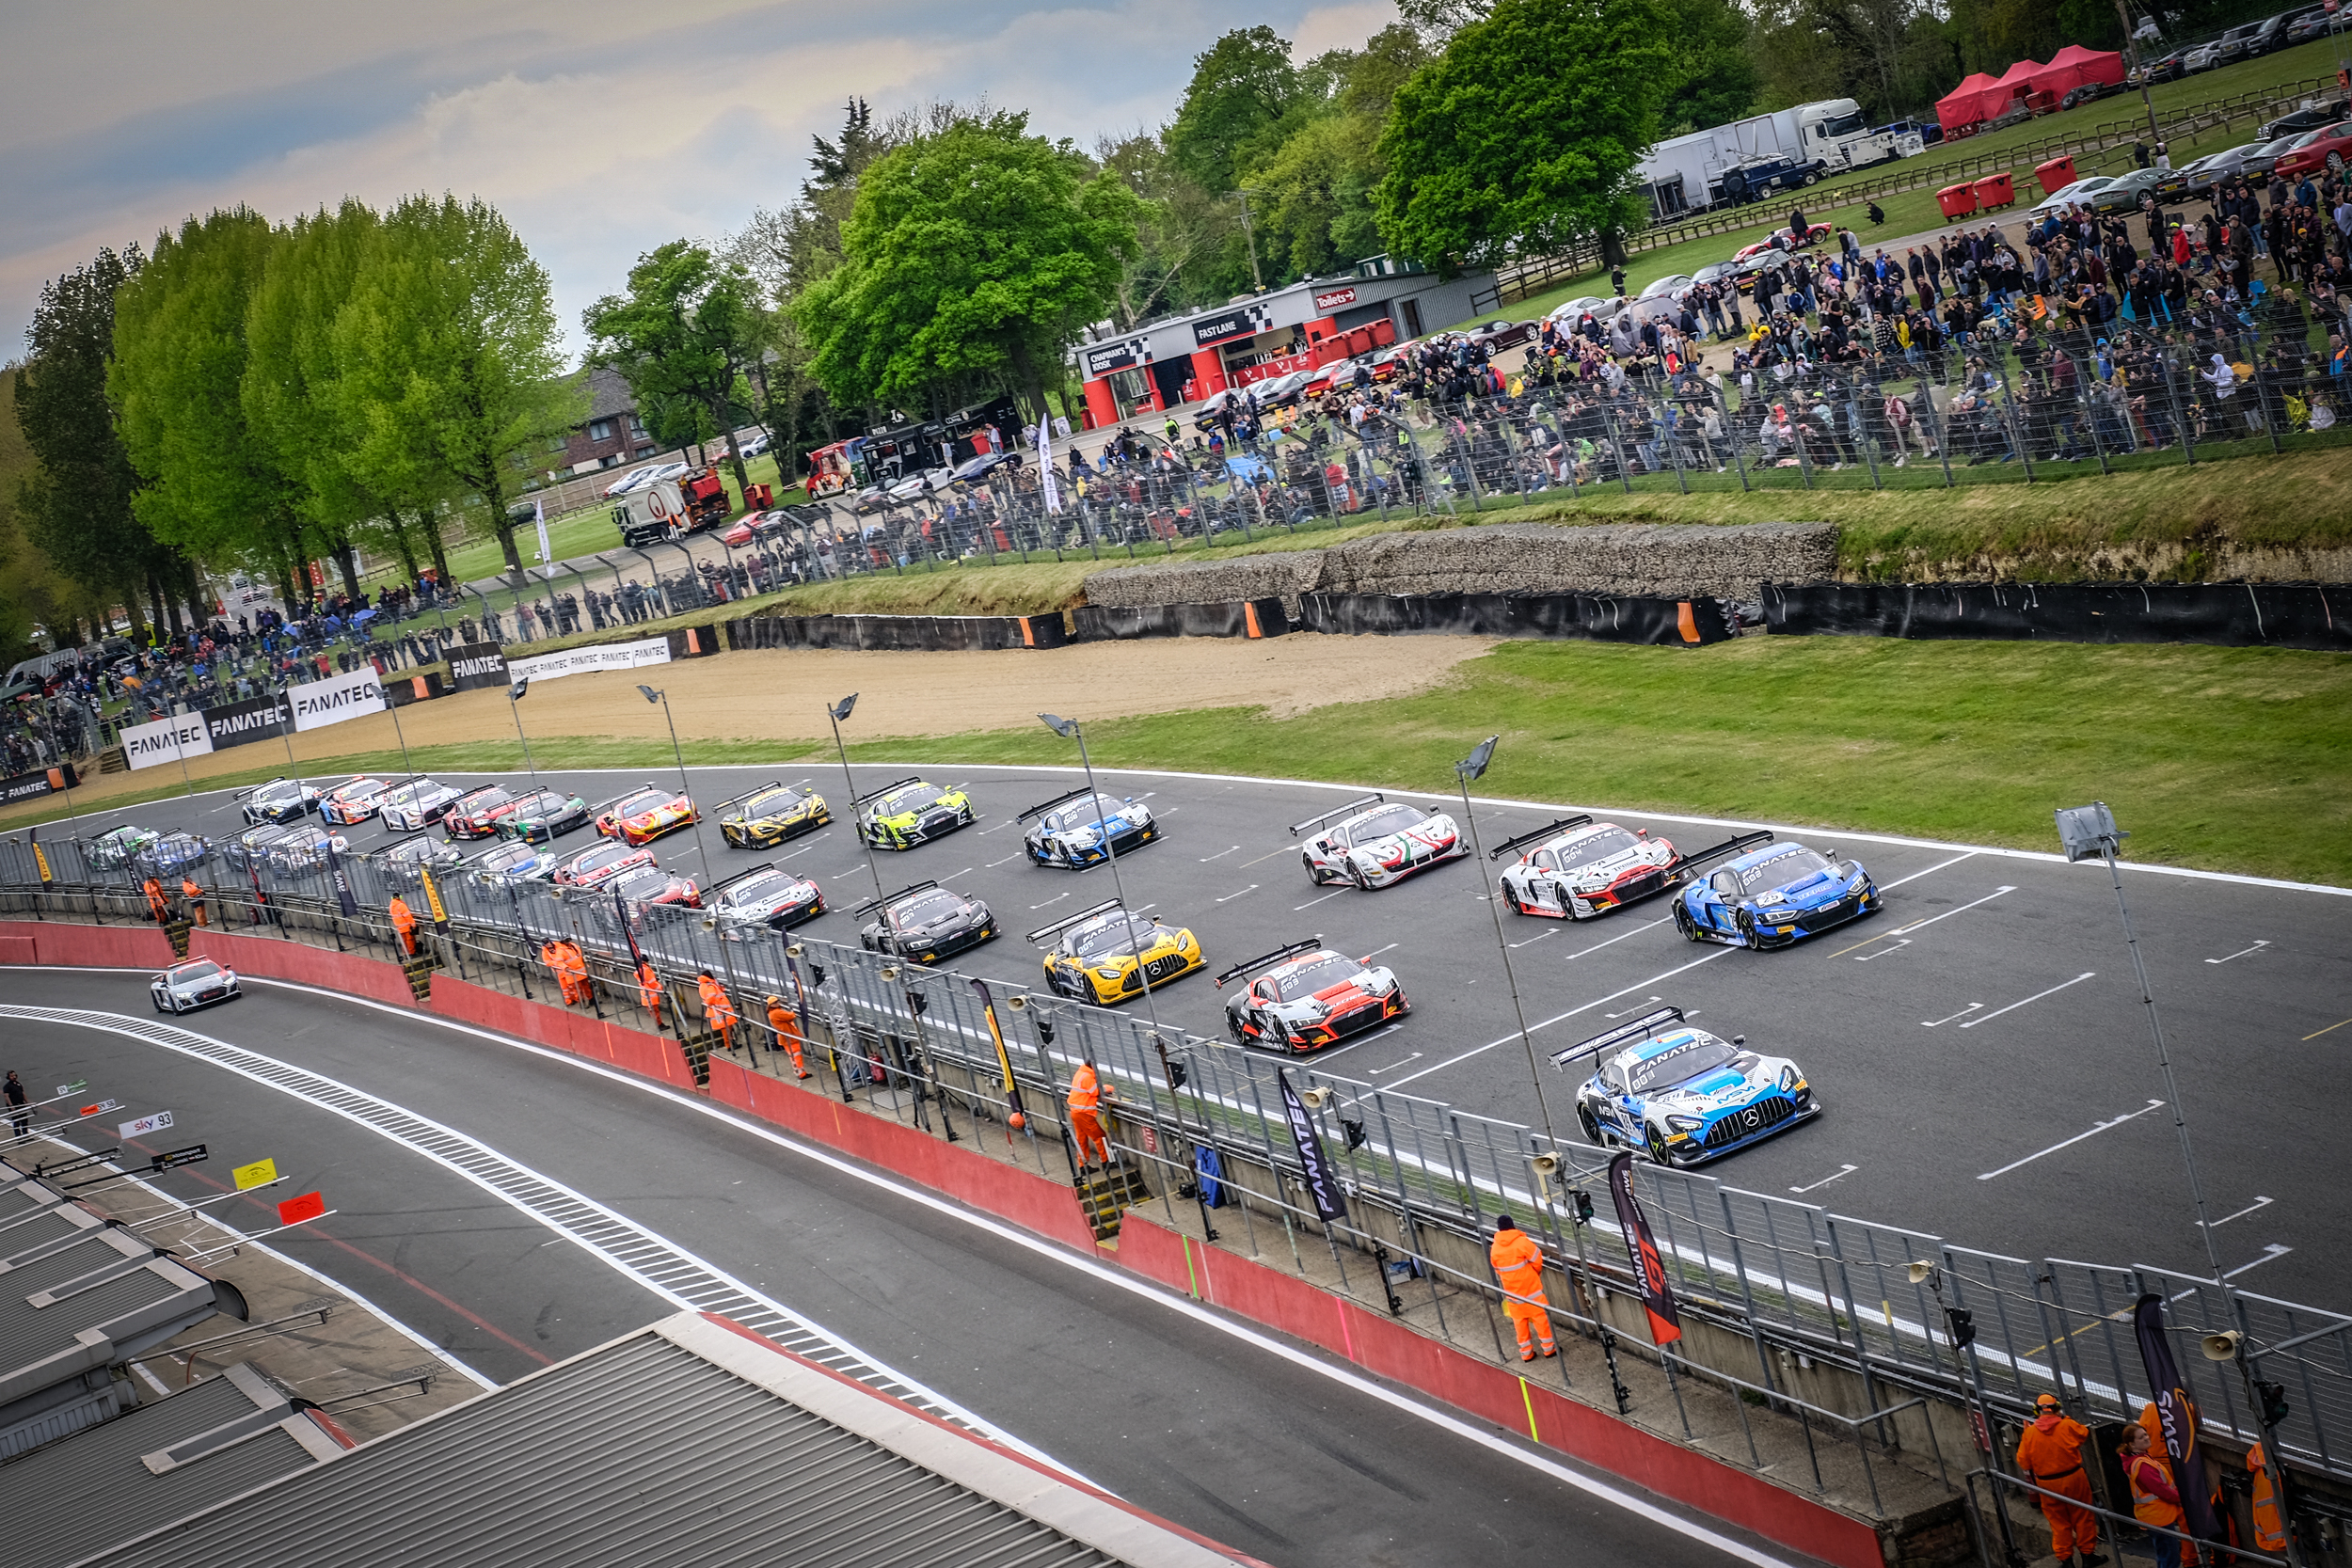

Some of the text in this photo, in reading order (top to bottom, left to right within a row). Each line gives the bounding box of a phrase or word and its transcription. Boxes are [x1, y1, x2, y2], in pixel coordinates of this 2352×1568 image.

[1317, 293, 1346, 309] Toilets
[1198, 320, 1237, 340] FAST LANE
[1089, 346, 1127, 363] CHAPMAN'S
[1091, 360, 1112, 372] KIOSK
[570, 654, 598, 667] FANATEC
[601, 651, 630, 662] FANATEC
[633, 646, 665, 658] FANATEC
[452, 654, 504, 678] FANATEC
[511, 664, 538, 677] FANATEC
[539, 659, 568, 673] FANATEC
[297, 682, 375, 717] FANATEC
[210, 705, 288, 737] FANATEC
[130, 726, 201, 755] FANATEC
[8, 780, 48, 798] FANATEC
[1355, 806, 1405, 830] FANATEC
[1562, 829, 1622, 858] FANATEC
[1564, 849, 1582, 864] 004
[1741, 848, 1808, 879] FANATEC
[899, 894, 950, 919] FANATEC
[1082, 915, 1140, 943] FANATEC
[1077, 940, 1095, 955] 005
[1280, 957, 1343, 987] FANATEC
[1280, 977, 1300, 994] 003
[1636, 1038, 1711, 1077] FANATEC
[134, 1113, 172, 1132] sky 93
[1283, 1088, 1335, 1213] FANATEC
[1624, 1222, 1651, 1299] FANATEC
